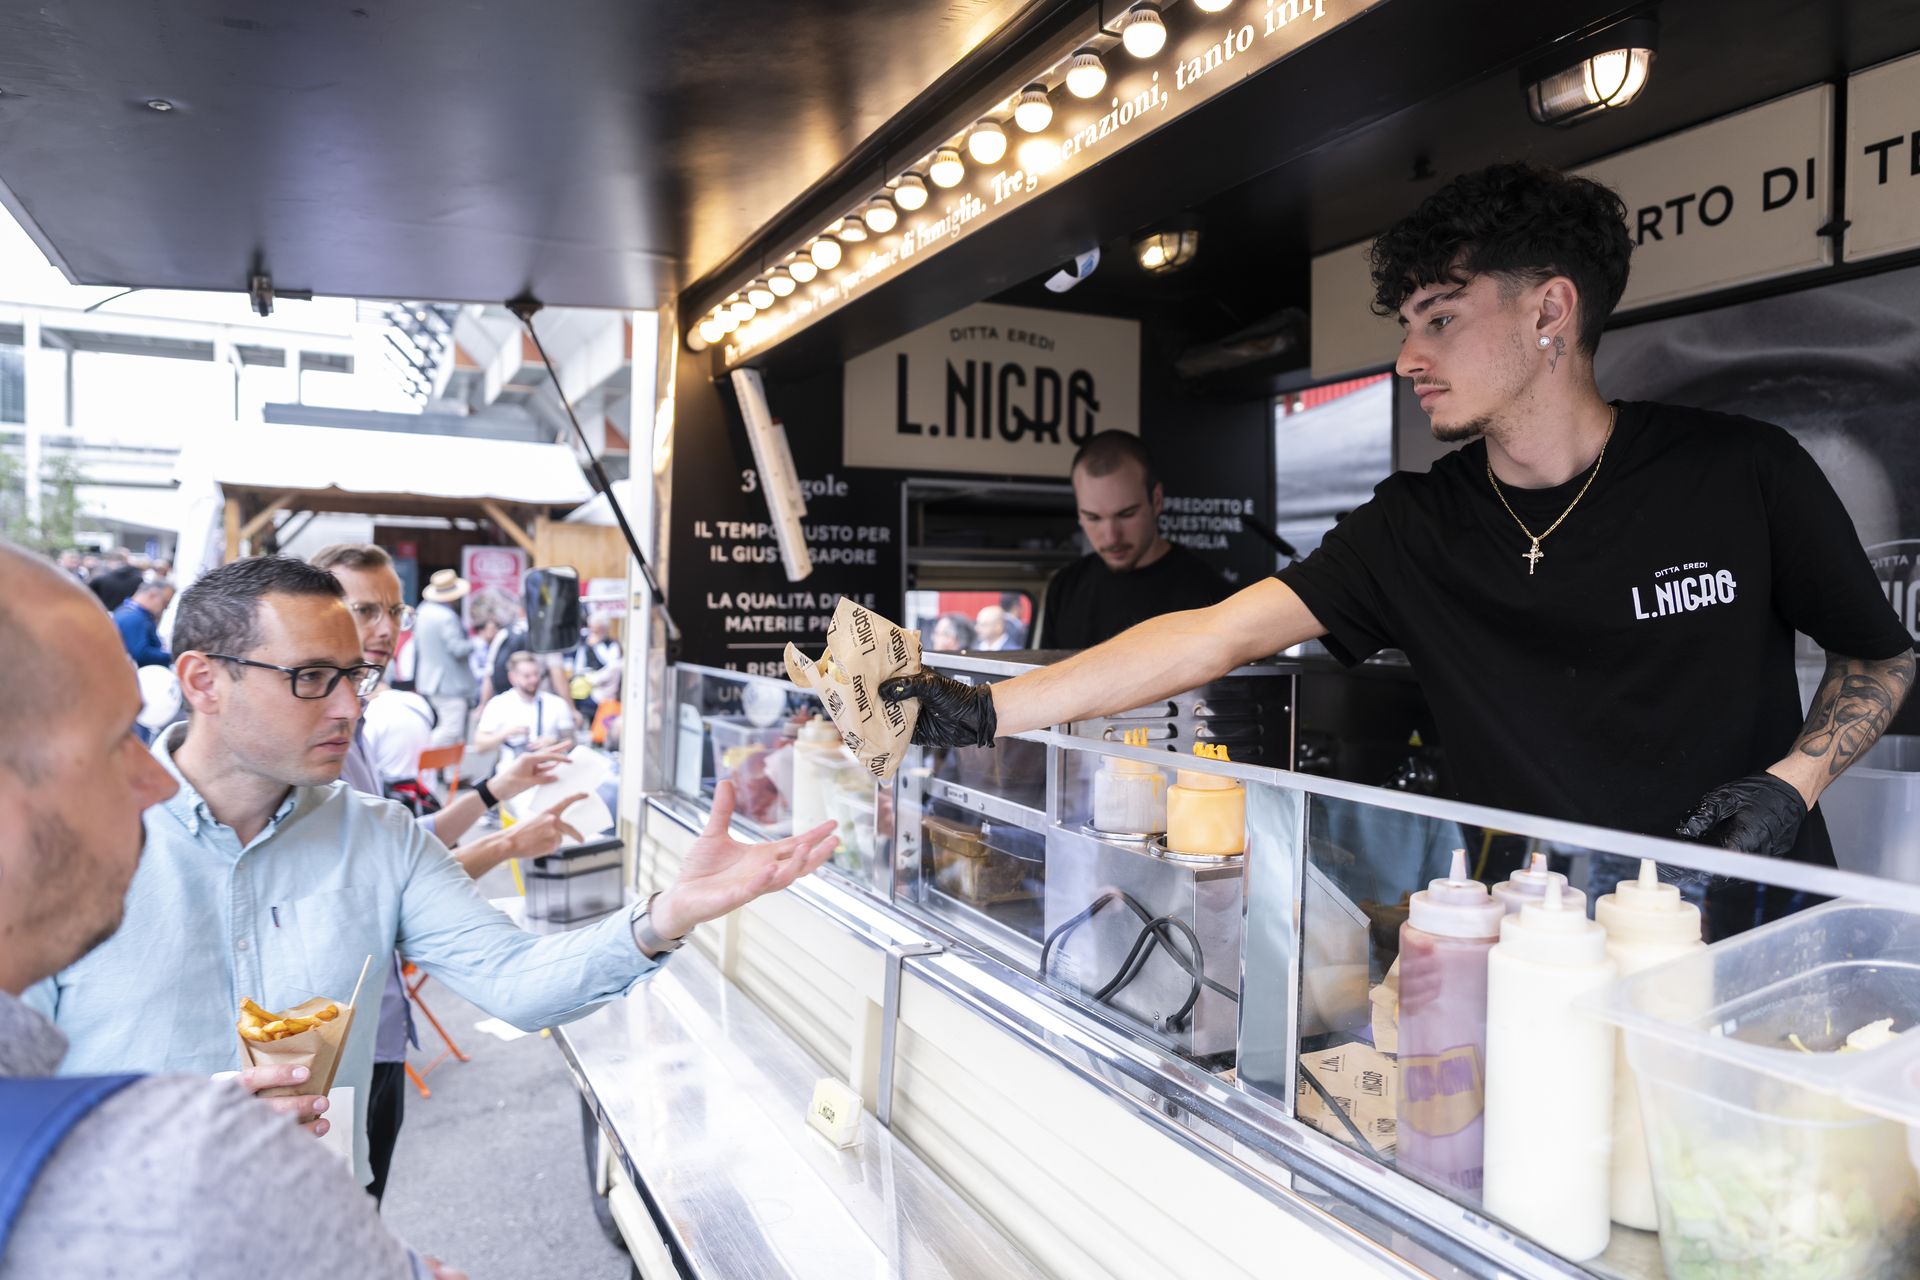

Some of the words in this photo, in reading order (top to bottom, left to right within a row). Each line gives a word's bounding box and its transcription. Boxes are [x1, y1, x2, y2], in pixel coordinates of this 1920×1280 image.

[991, 169, 1023, 205] Tre
[1176, 25, 1255, 90] tanto
[1637, 185, 1734, 246] RTO
[1762, 158, 1815, 211] DI
[950, 326, 999, 342] DITTA
[1007, 328, 1055, 351] EREDI
[897, 353, 1100, 446] L.NIGRO
[741, 469, 757, 493] 3
[799, 474, 849, 501] gole
[695, 521, 712, 537] IL
[857, 527, 891, 543] PER
[711, 545, 728, 562] IL
[808, 547, 877, 565] SAPORE
[1654, 566, 1680, 578] DITTA
[1683, 562, 1708, 570] EREDI
[707, 592, 733, 609] LA
[1631, 569, 1737, 620] L.NIGRO
[725, 615, 805, 632] MATERIE
